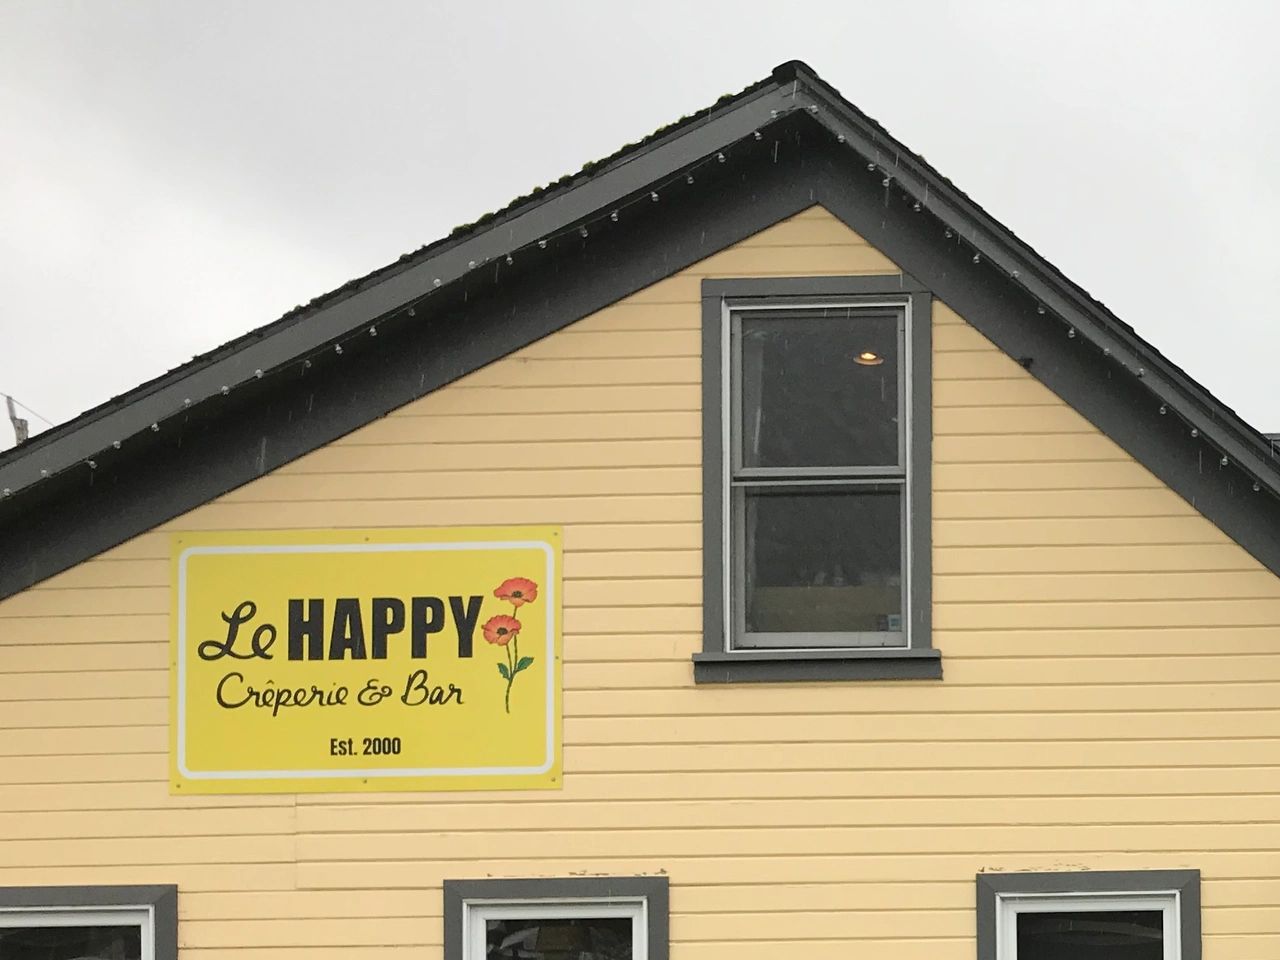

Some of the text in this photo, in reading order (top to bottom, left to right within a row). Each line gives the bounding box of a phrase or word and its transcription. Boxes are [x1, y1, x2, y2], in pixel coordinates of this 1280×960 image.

[198, 595, 485, 661] Le HAPPY
[216, 669, 465, 717] Crêperie & Bar
[330, 736, 402, 757] Est. 2000
